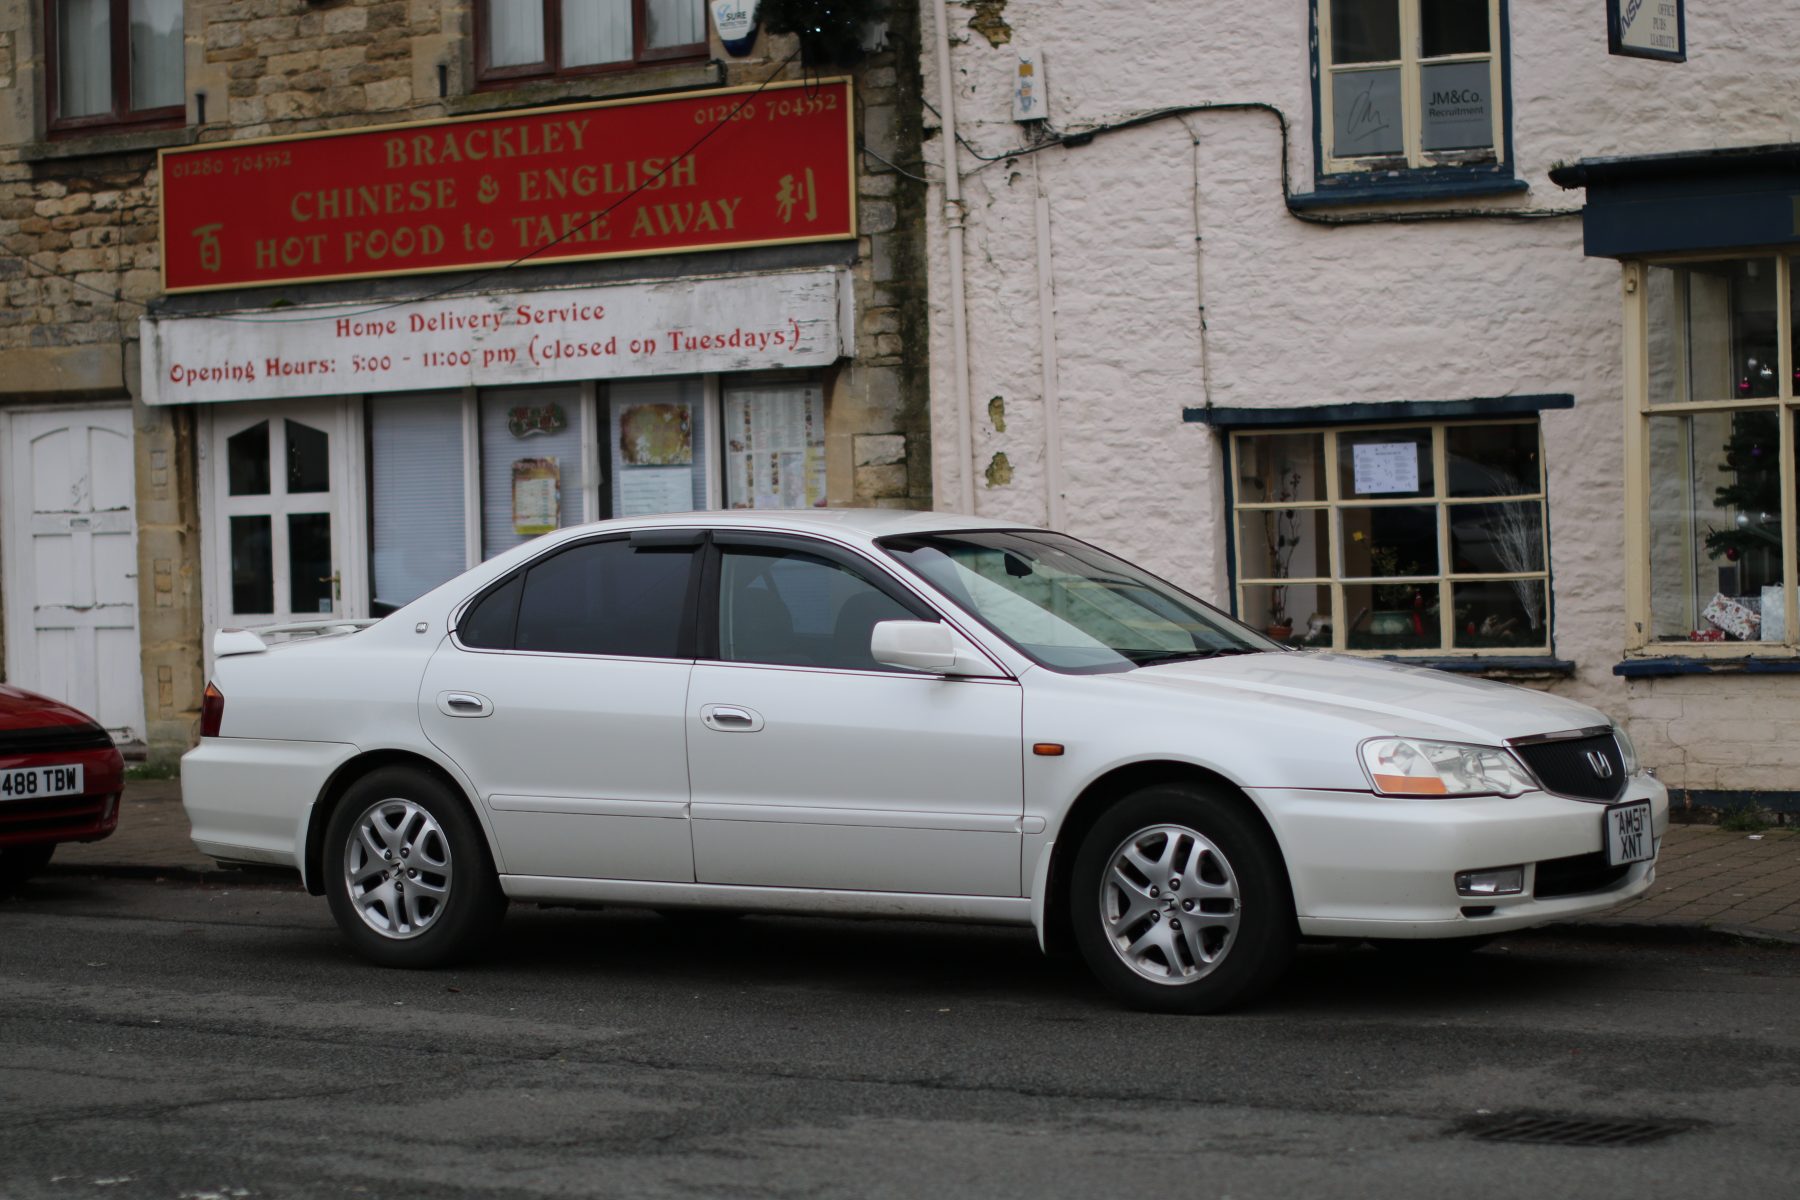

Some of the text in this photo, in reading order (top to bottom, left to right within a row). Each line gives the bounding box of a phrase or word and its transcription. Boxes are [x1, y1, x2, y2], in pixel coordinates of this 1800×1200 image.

[694, 94, 837, 125] 01280 704552
[1428, 89, 1484, 106] JM&Co.
[1428, 106, 1485, 118] Recruitment
[384, 118, 591, 169] BRACKLEY
[172, 158, 223, 178] 01280
[290, 153, 698, 223] CHINESE & ENGLISH
[255, 197, 743, 270] HOT FOOD to TAKE AWAY
[335, 302, 606, 339] Home Delivery Service
[169, 360, 257, 387] Opening
[265, 356, 336, 378] Hours:
[351, 353, 392, 374] 5:00
[422, 350, 472, 367] 11:00
[482, 346, 517, 368] pm
[528, 333, 618, 367] (closed
[628, 338, 657, 358] on
[666, 317, 801, 352] Tuesdays)
[2, 767, 76, 796] 488 TBW
[1618, 806, 1644, 836] AM51
[1620, 832, 1643, 860] XNT
